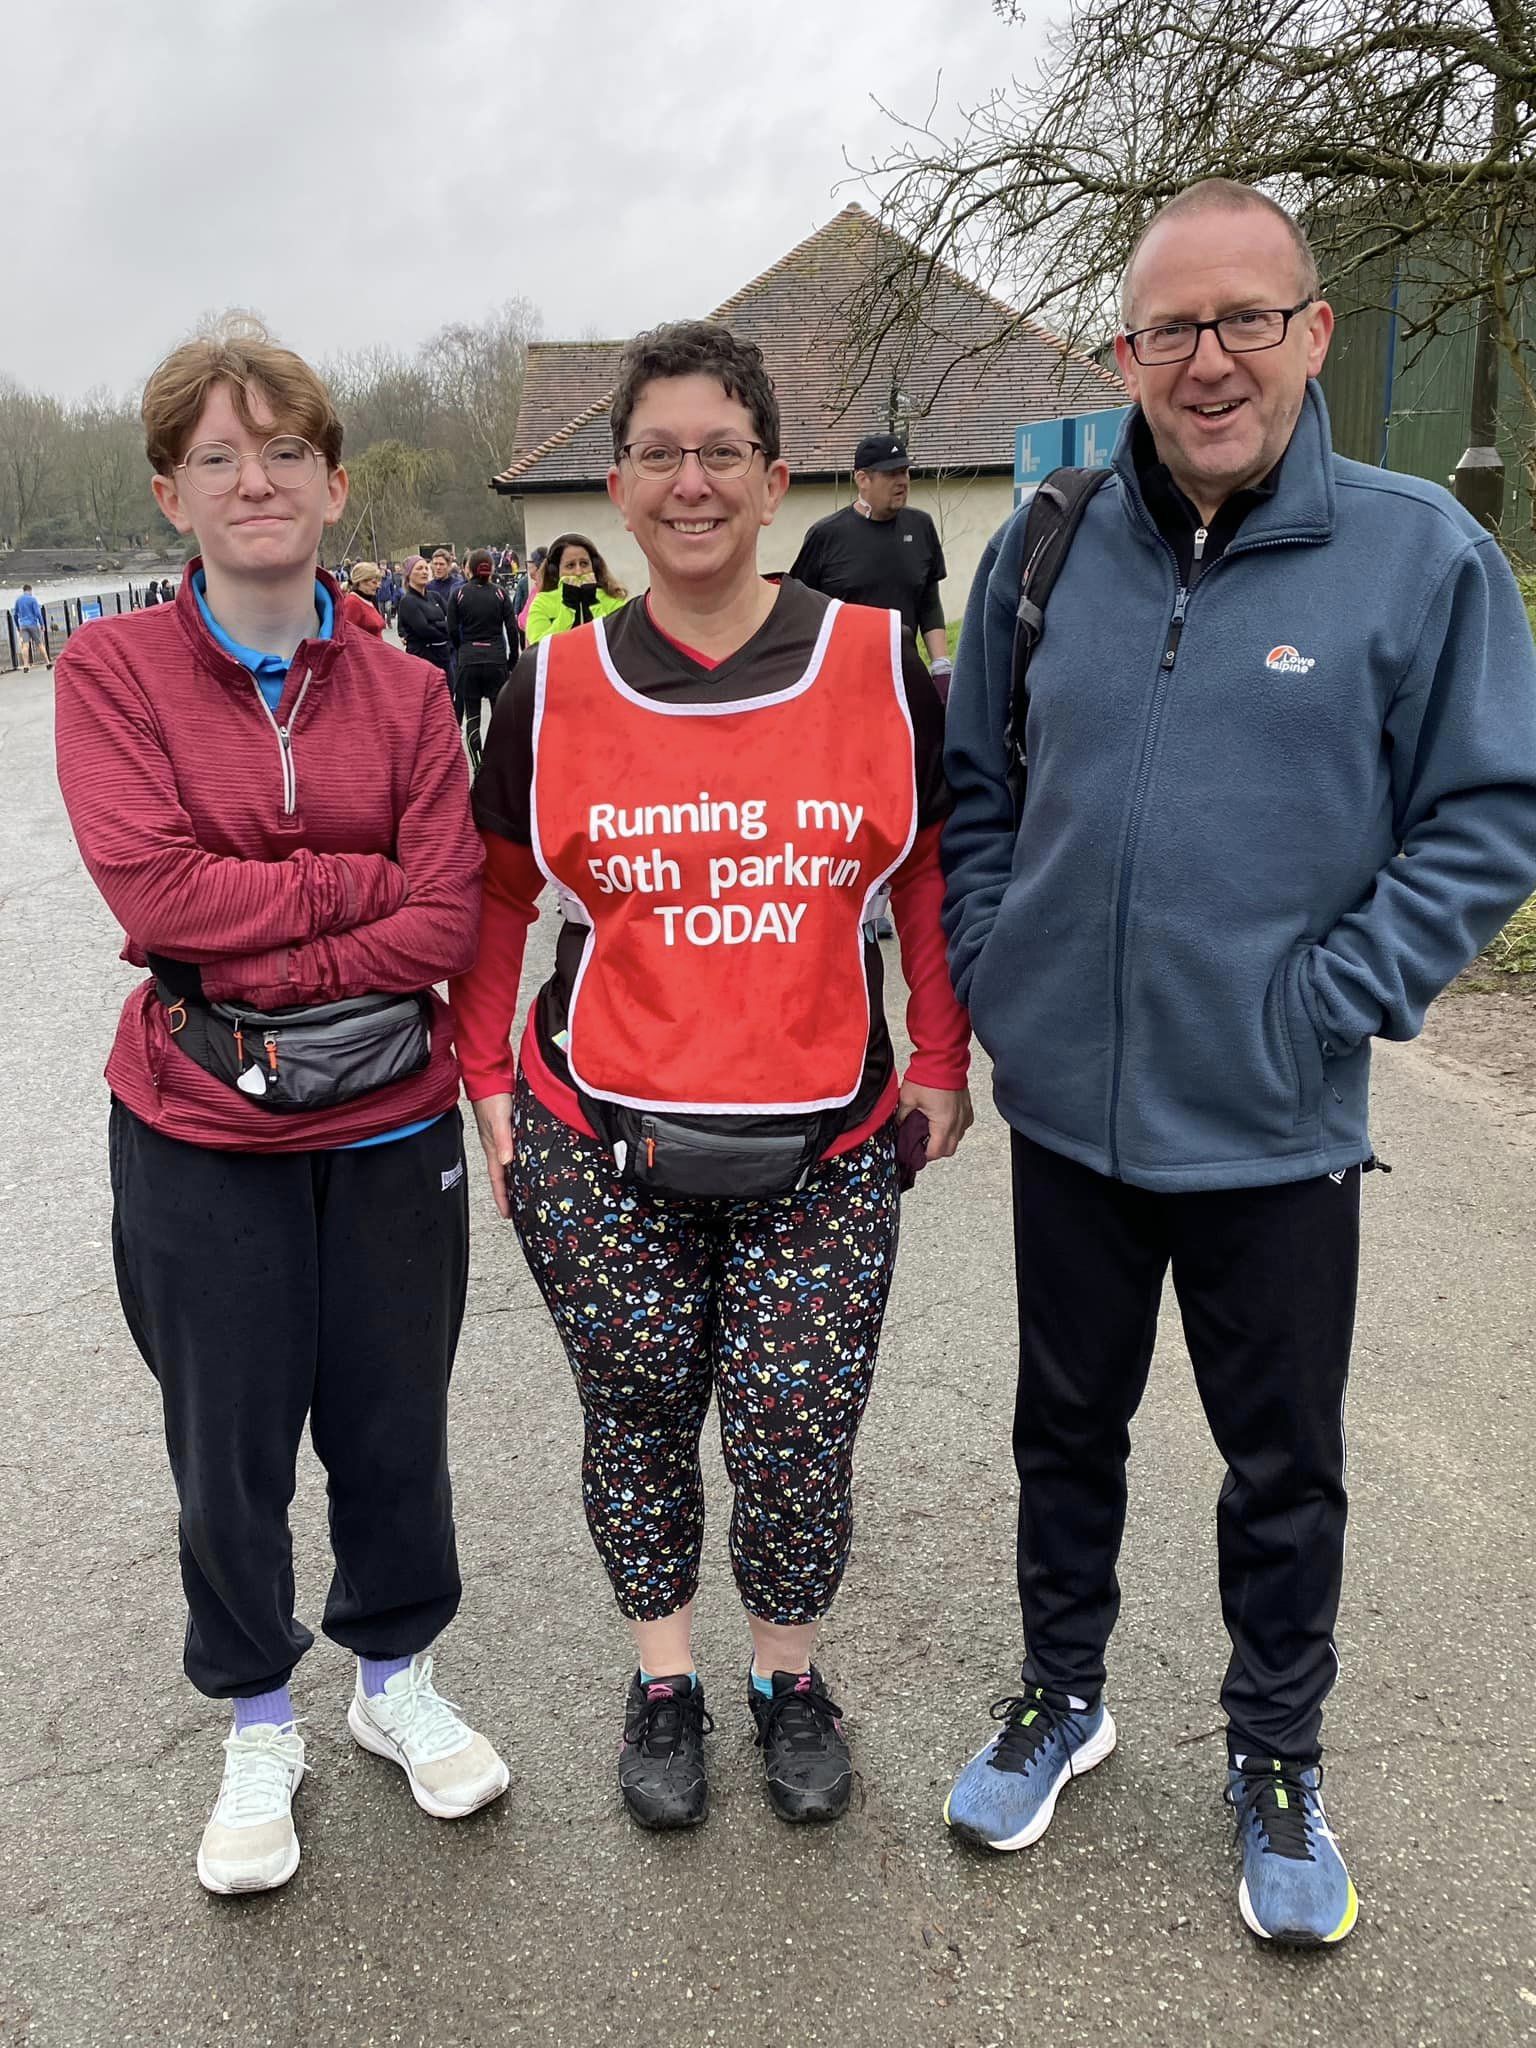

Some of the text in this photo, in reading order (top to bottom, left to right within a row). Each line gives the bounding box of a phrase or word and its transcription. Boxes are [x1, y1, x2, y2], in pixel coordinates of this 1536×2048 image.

[1271, 660, 1308, 673] alpine
[1283, 653, 1315, 667] Lowe
[589, 791, 864, 843] Running my
[588, 842, 861, 899] 50th parkrun
[653, 902, 808, 946] TODAY
